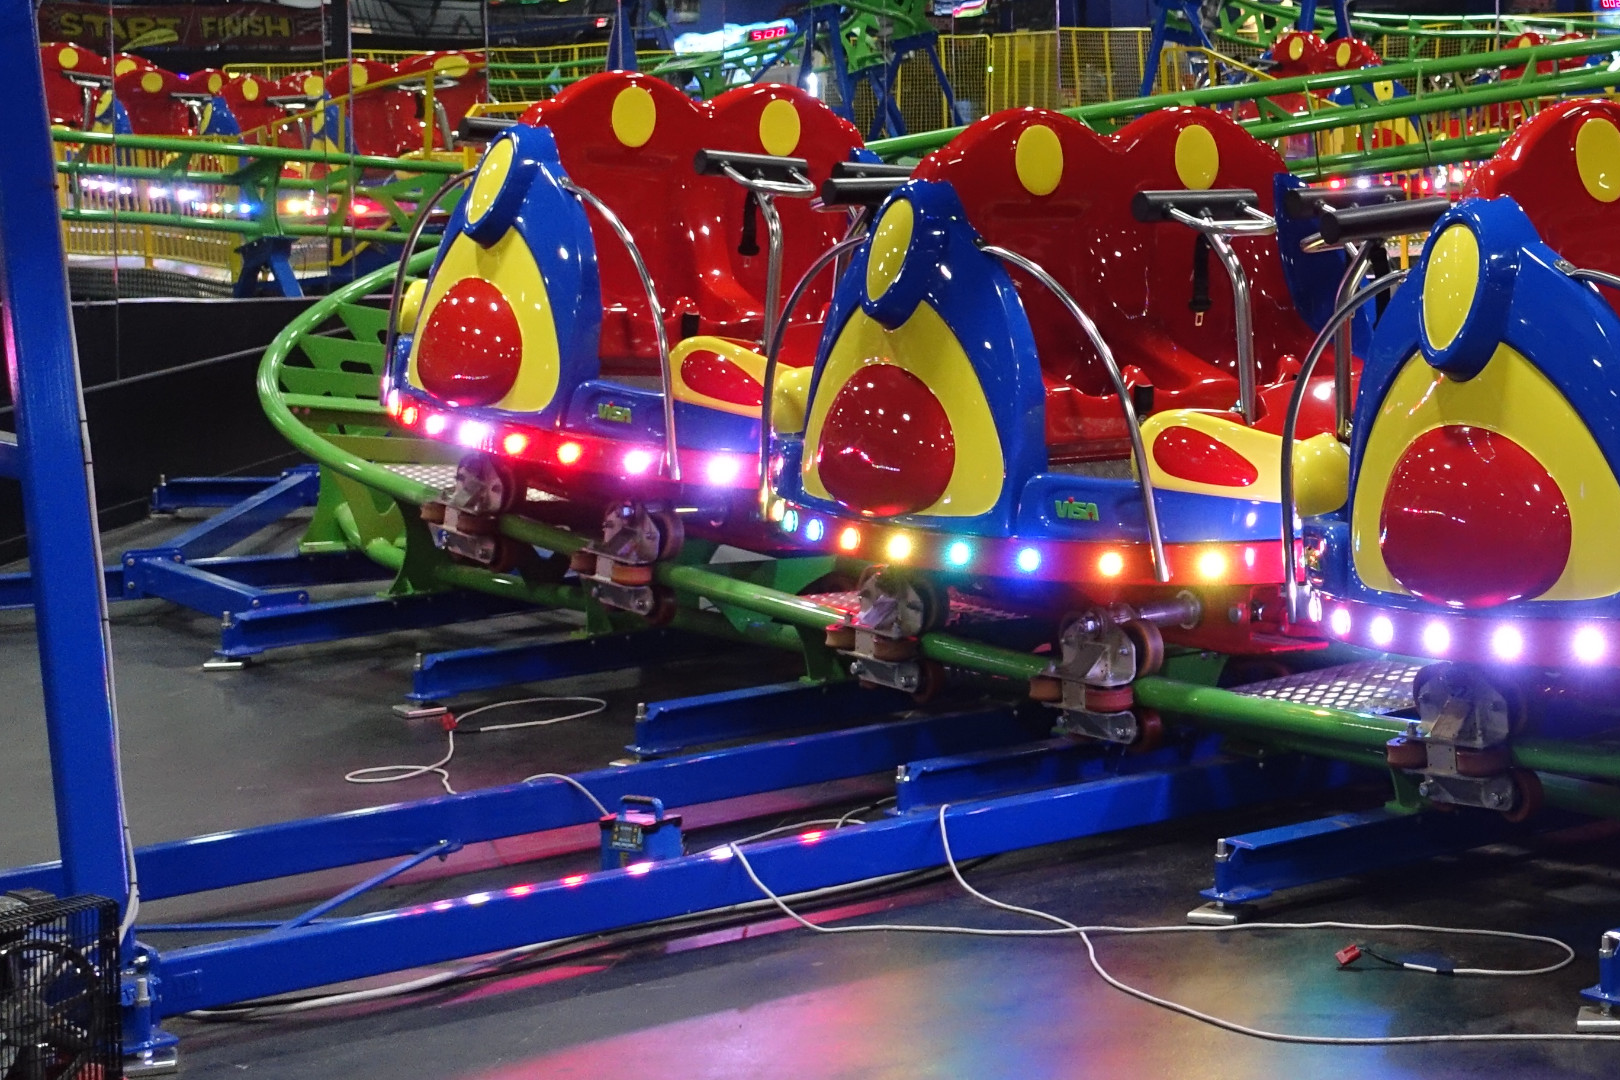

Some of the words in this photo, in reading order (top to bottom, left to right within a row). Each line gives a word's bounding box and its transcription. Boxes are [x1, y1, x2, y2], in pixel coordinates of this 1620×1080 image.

[60, 13, 182, 38] START
[200, 16, 291, 38] FINISH
[752, 27, 786, 41] 500
